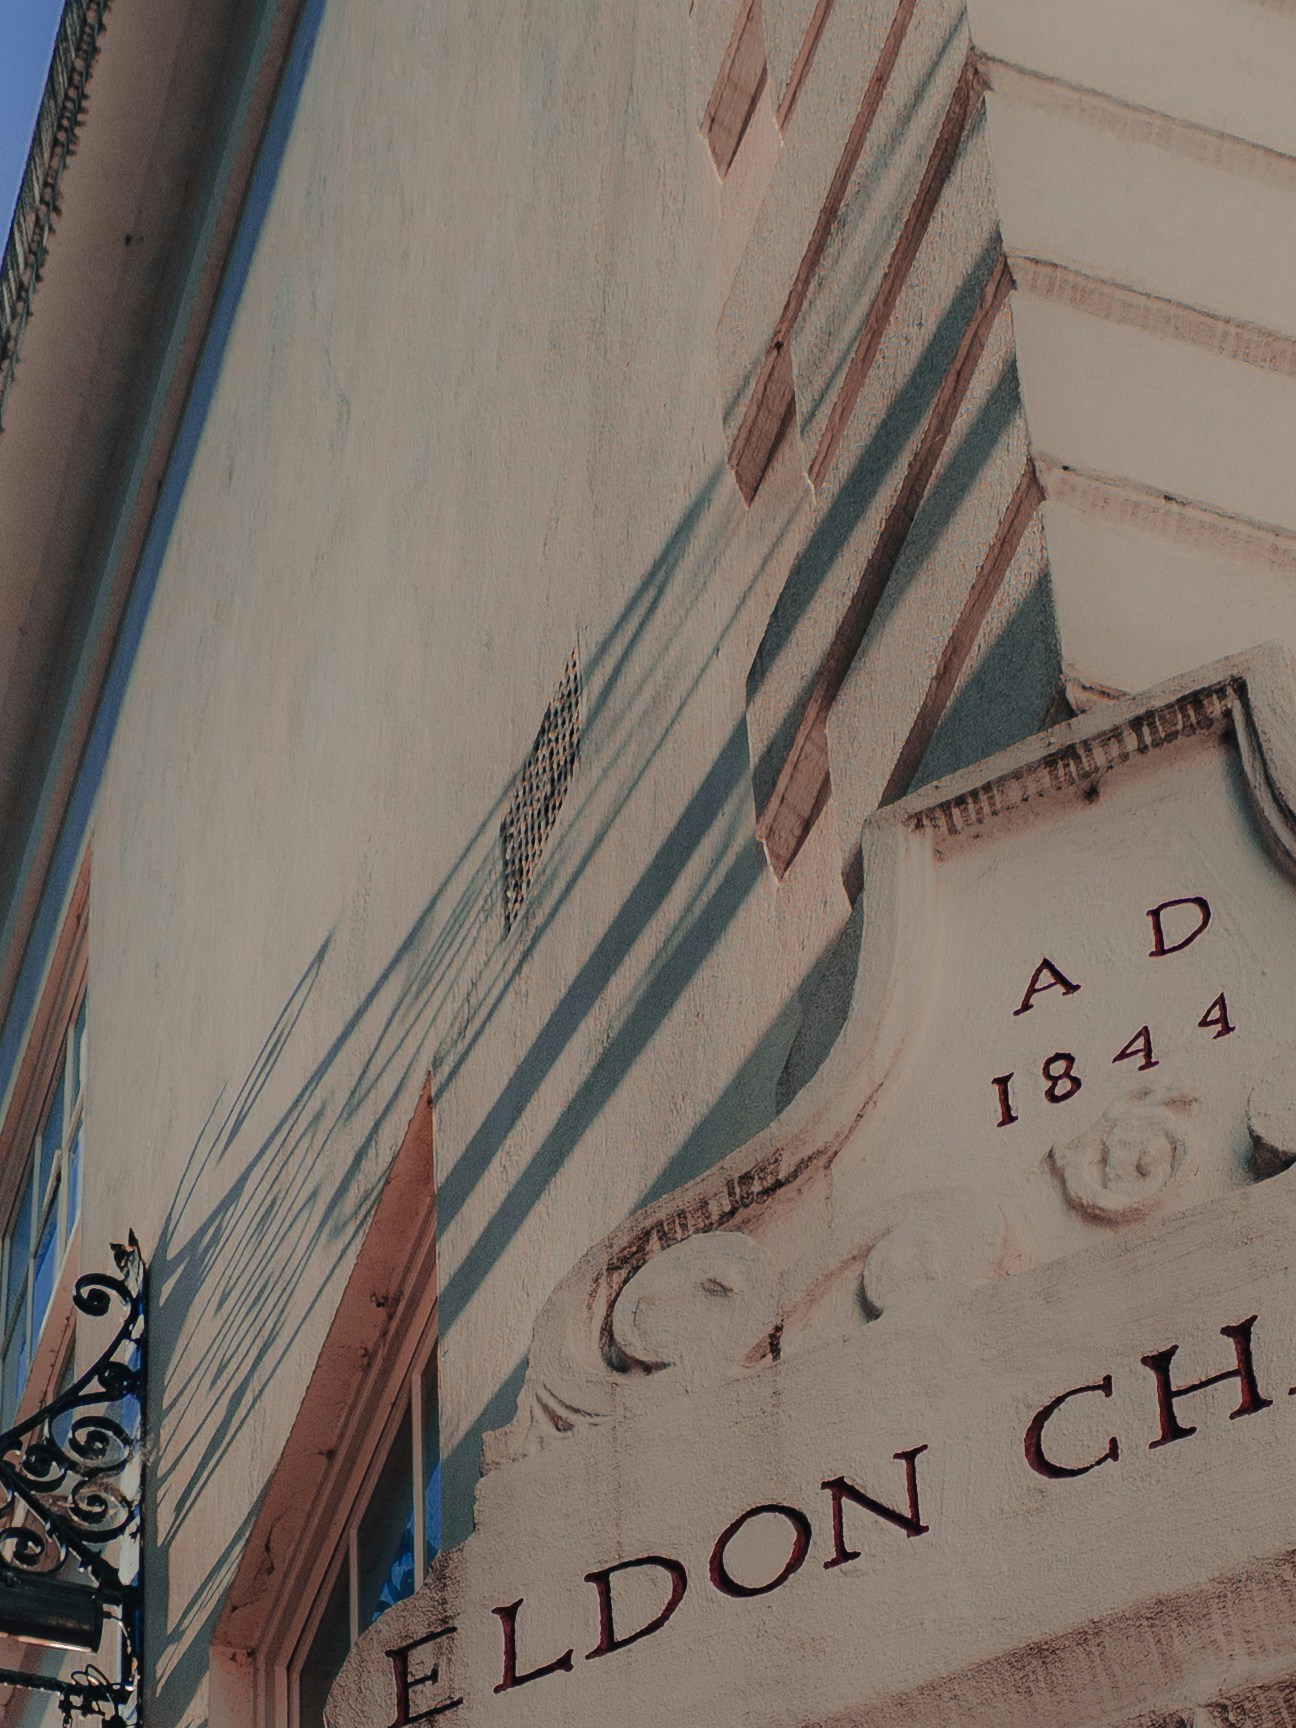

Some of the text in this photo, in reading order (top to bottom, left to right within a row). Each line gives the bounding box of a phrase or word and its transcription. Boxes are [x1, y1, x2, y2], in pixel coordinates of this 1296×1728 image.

[1012, 896, 1213, 1017] A D
[990, 990, 1240, 1131] 1844
